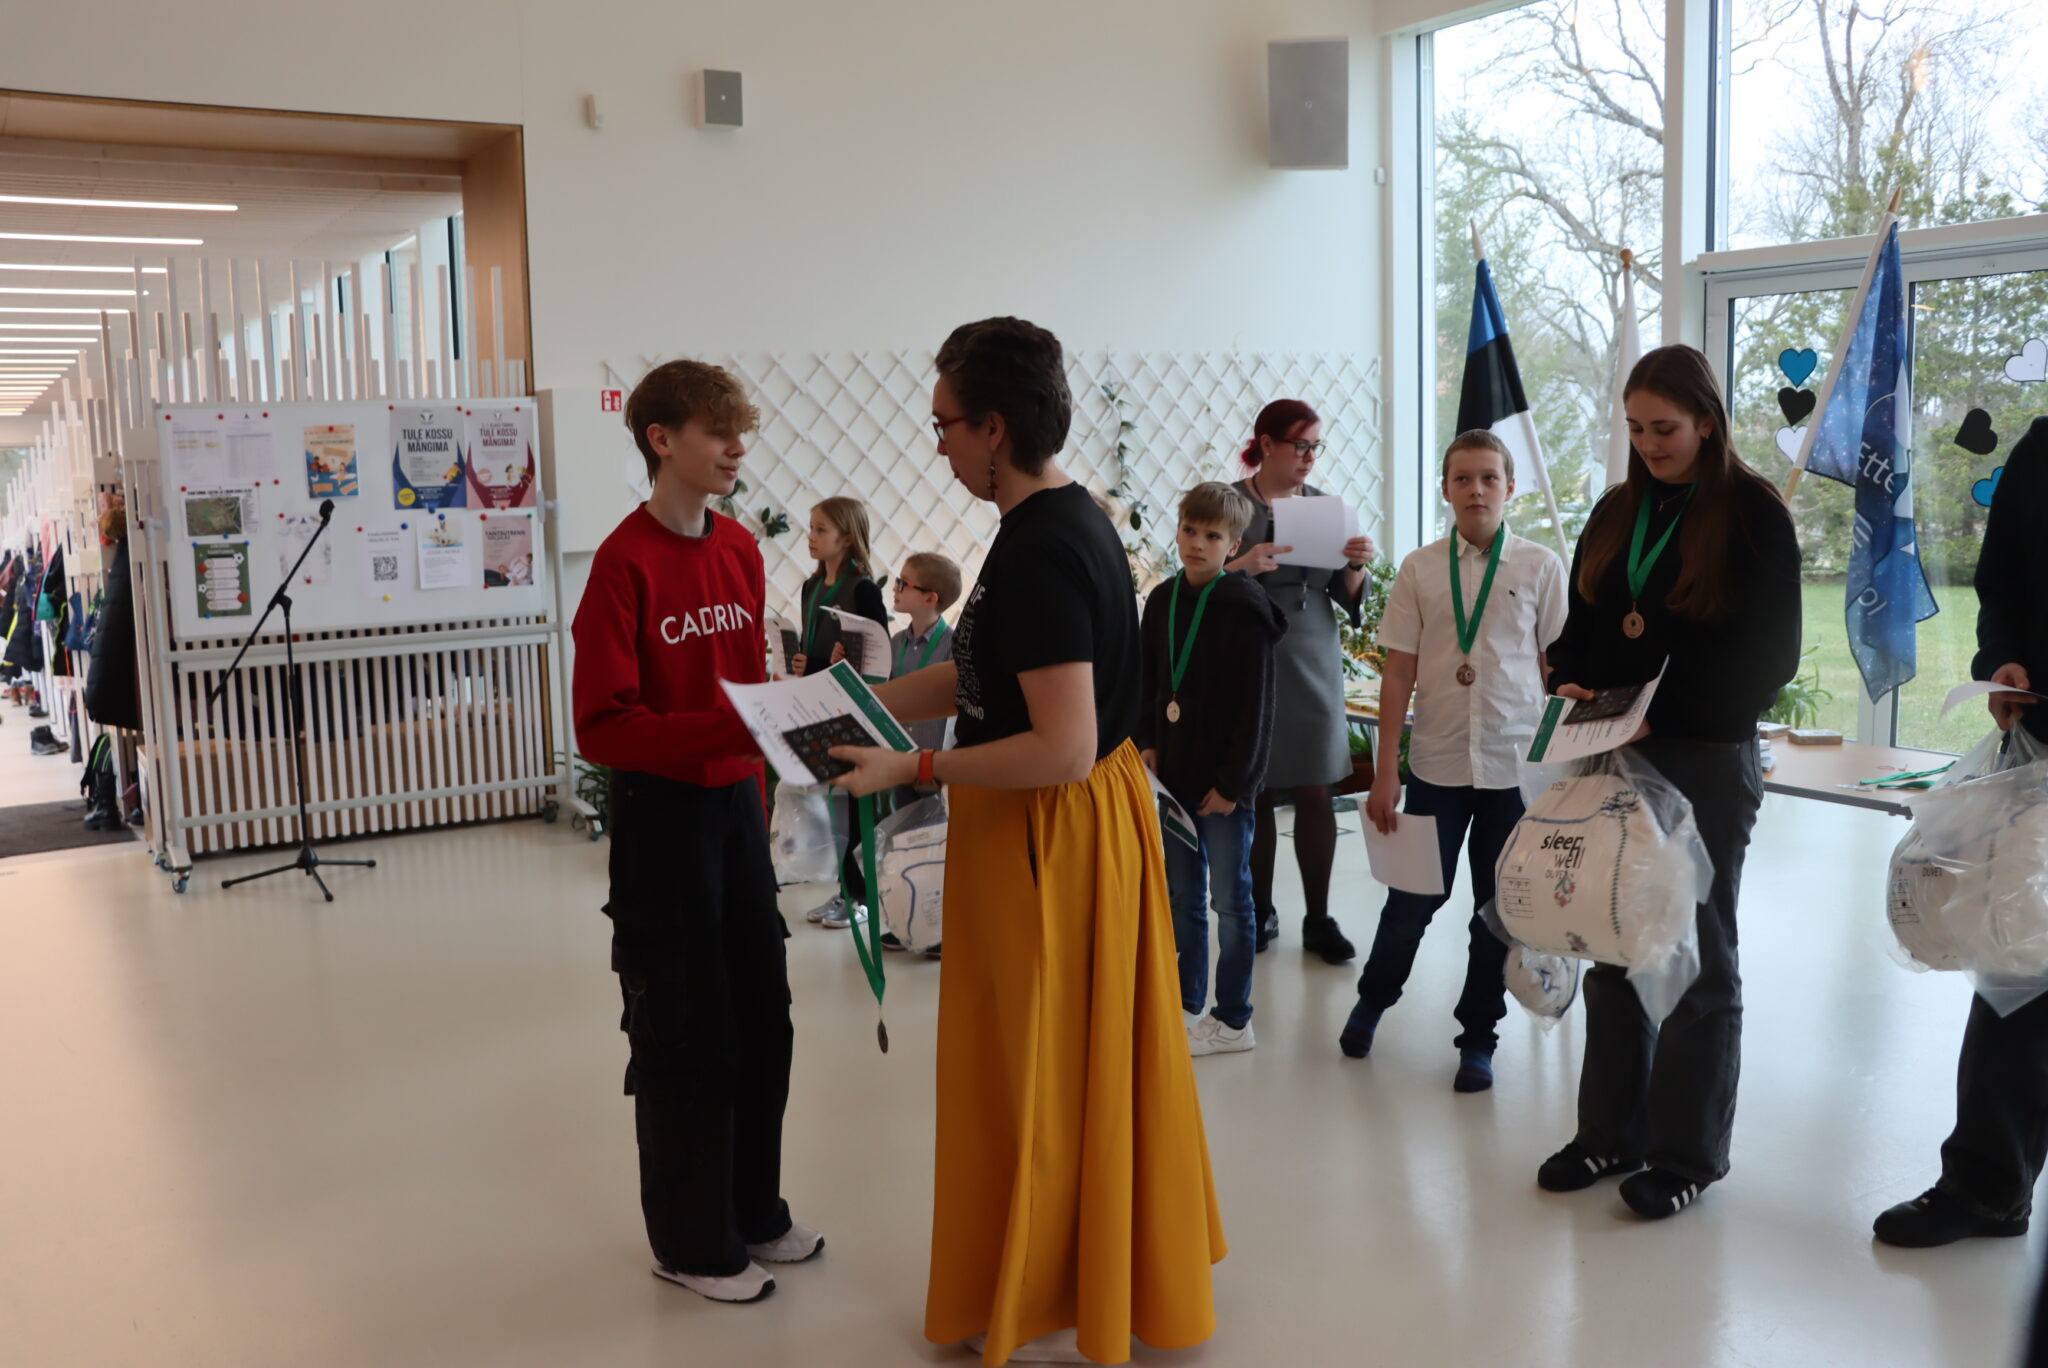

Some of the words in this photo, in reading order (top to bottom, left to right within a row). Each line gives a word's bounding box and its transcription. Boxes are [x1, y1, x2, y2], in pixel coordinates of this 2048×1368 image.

[402, 428, 423, 440] TULE
[426, 428, 453, 439] KOSSU
[1540, 829, 1584, 856] sleep
